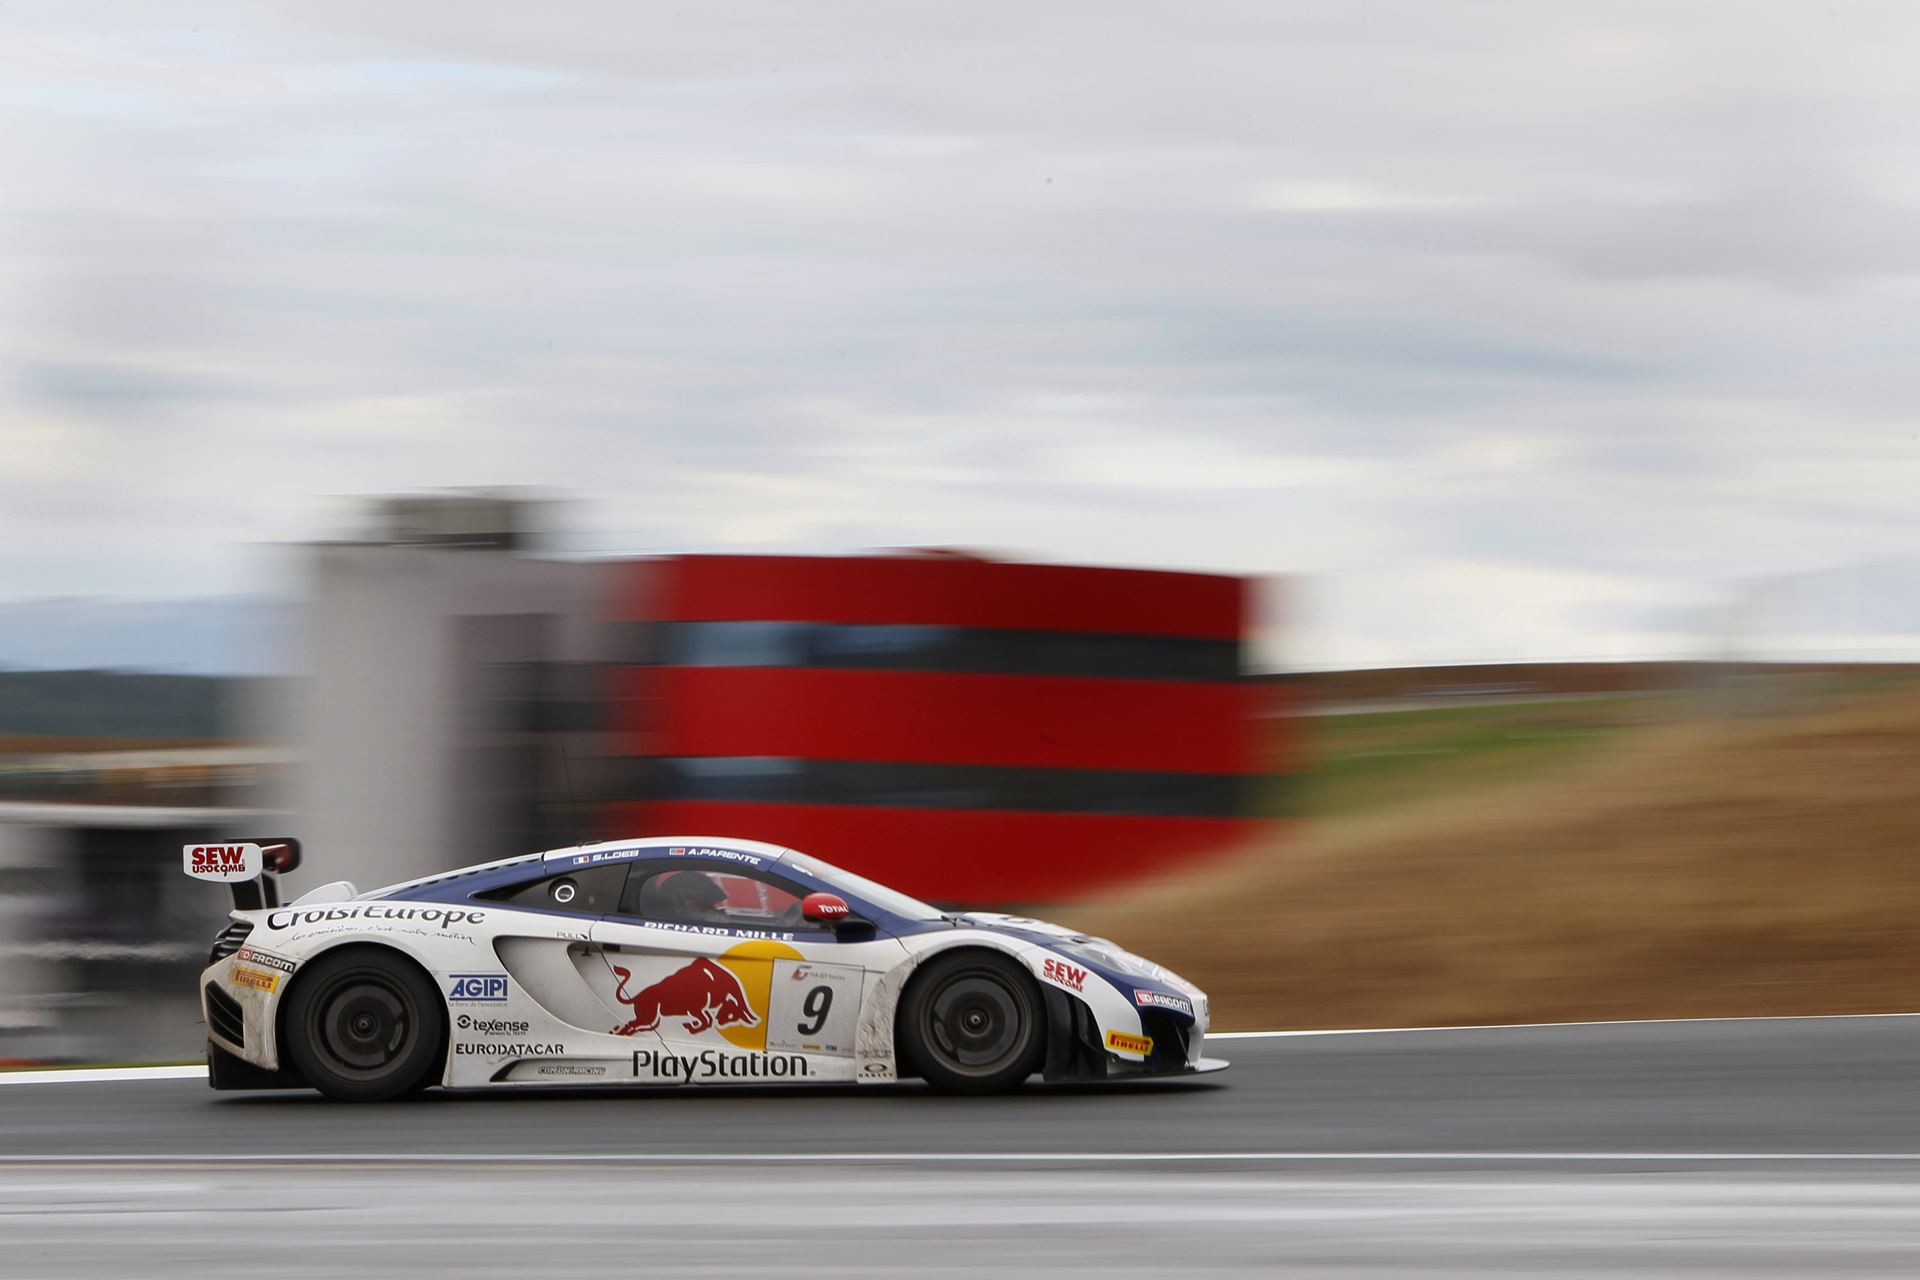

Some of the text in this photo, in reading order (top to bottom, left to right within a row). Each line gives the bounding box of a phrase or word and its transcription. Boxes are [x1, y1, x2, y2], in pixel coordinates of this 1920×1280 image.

[192, 846, 244, 865] SEW
[592, 849, 640, 862] S.LOEB
[687, 848, 761, 865] A.PARENTE
[267, 904, 486, 930] CroisiEurope
[818, 904, 849, 913] TOTAL
[644, 920, 795, 942] RICHARD MILLE
[251, 953, 295, 972] FACOM
[1043, 958, 1087, 985] SEW
[449, 979, 508, 997] AGIPI
[797, 985, 834, 1036] 9
[1153, 993, 1190, 1012] FACOM
[473, 1019, 530, 1035] texense
[456, 1043, 564, 1055] EURODATACAR
[1110, 1034, 1151, 1053] PIRELLI
[632, 1050, 808, 1084] PlayStation
